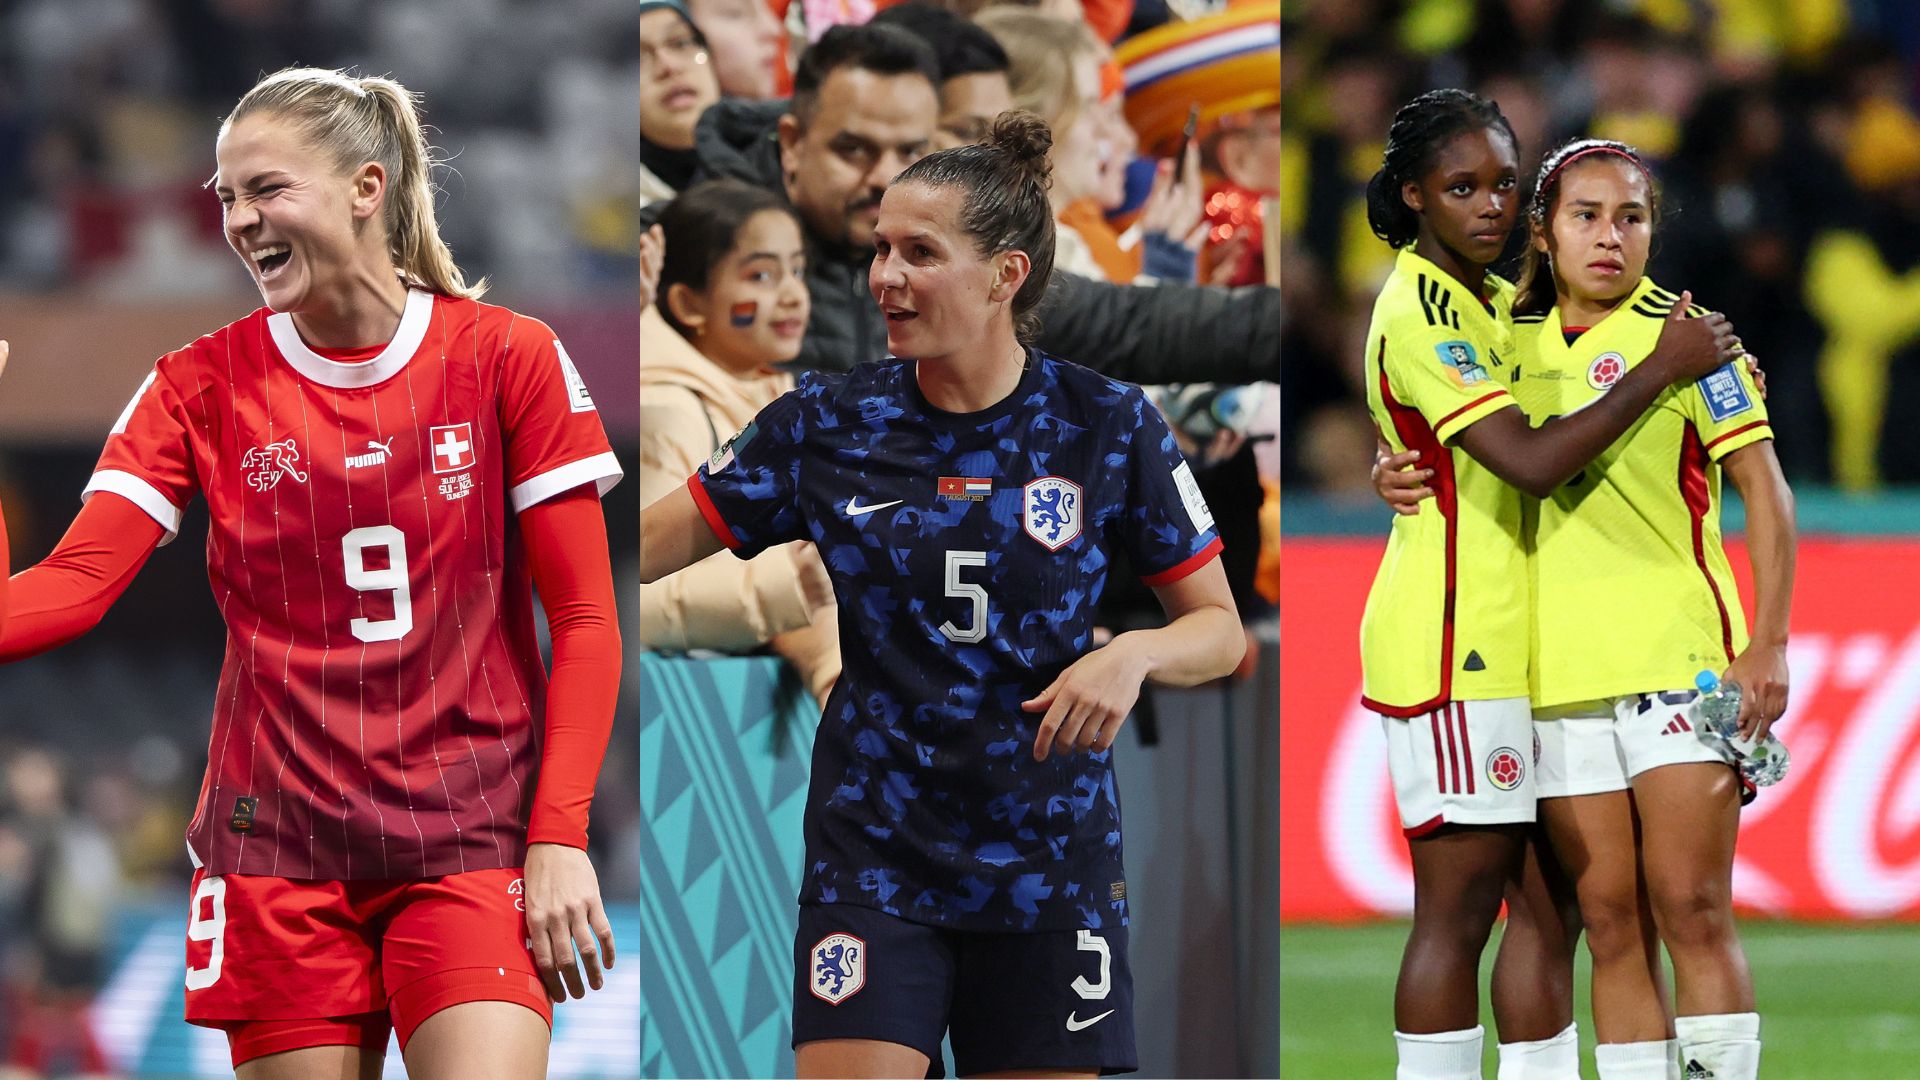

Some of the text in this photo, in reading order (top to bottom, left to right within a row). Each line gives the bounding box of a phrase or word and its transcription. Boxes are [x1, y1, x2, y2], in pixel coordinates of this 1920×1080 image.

[345, 451, 386, 469] PUMA
[438, 483, 453, 495] SUI
[459, 479, 475, 491] NZL
[341, 524, 414, 643] 9
[938, 549, 989, 644] 5
[184, 876, 227, 992] 9
[1070, 929, 1112, 1000] 5
